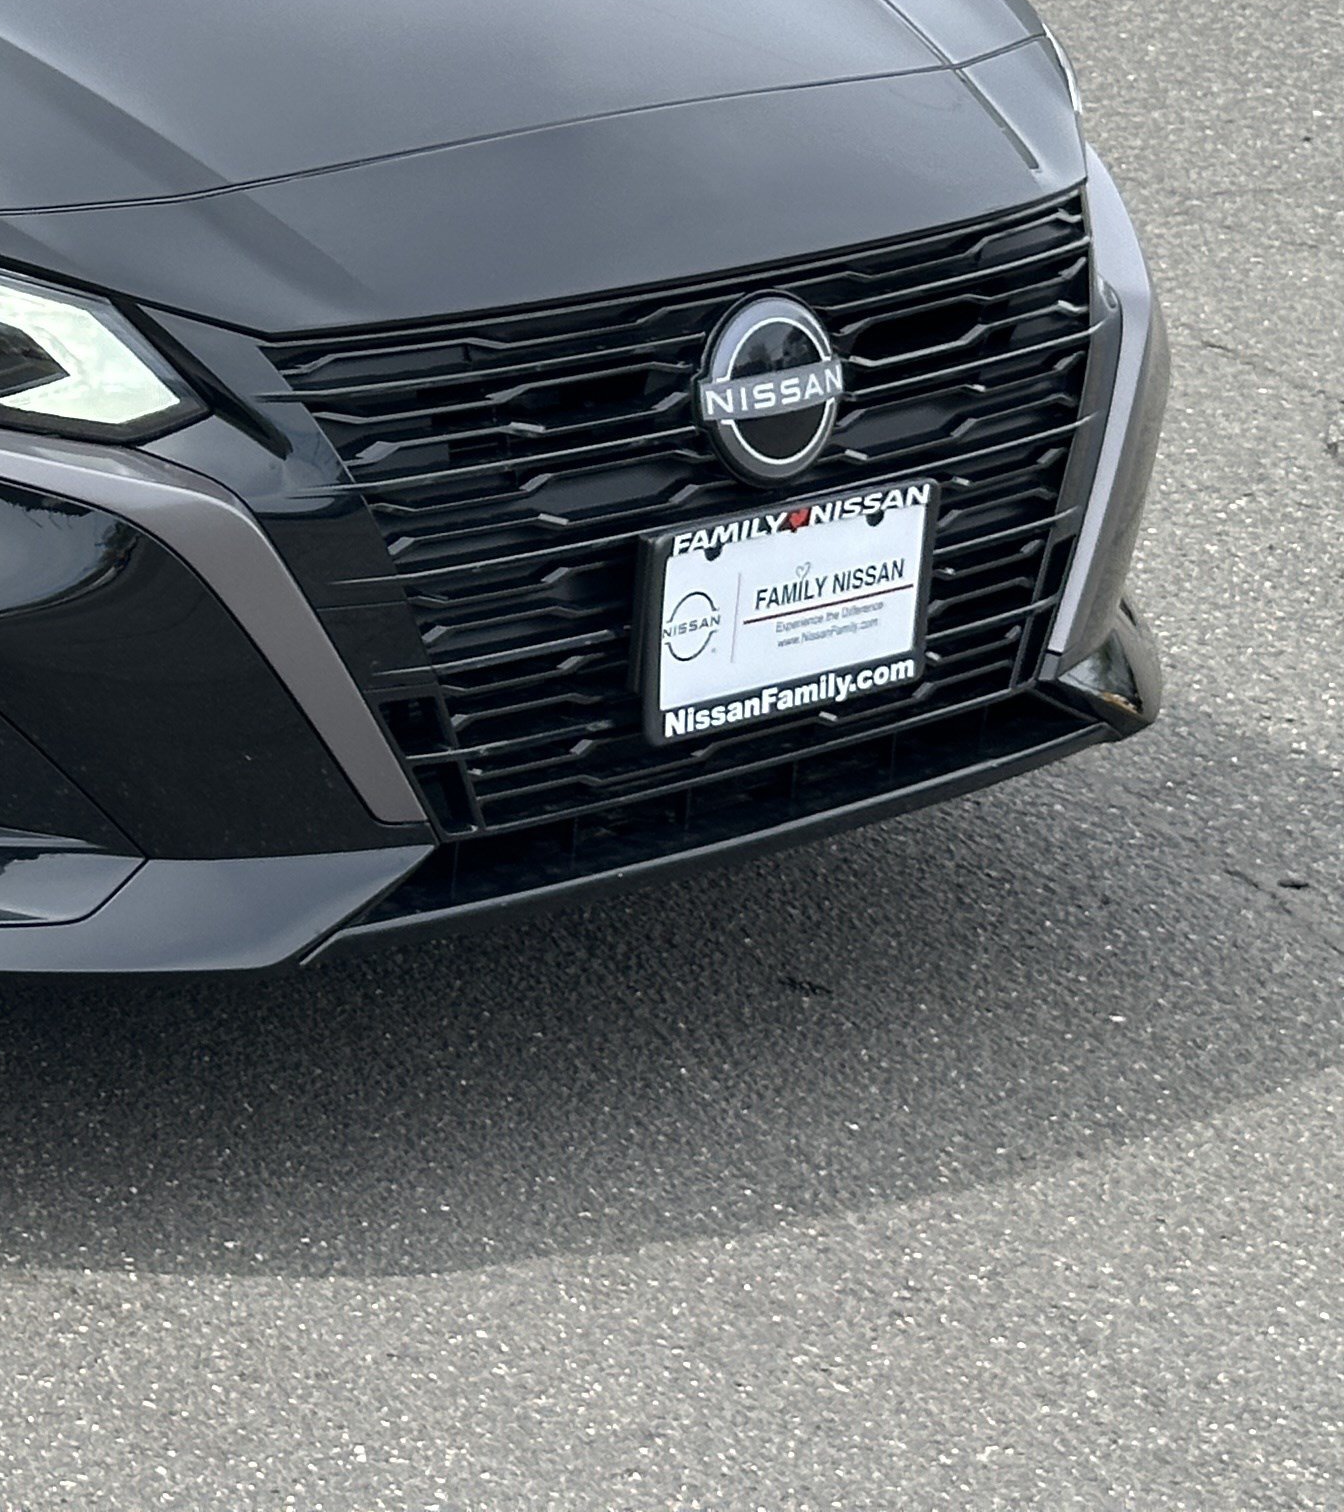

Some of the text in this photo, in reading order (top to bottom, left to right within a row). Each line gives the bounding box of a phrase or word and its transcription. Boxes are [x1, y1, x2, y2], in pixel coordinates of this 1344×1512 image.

[705, 364, 844, 416] NISSAN
[672, 483, 931, 557] FAMILY NISSAN
[755, 558, 905, 611] FAMILY NISSAN
[662, 614, 721, 639] NISSAN
[664, 658, 915, 738] NissanFamily.com
